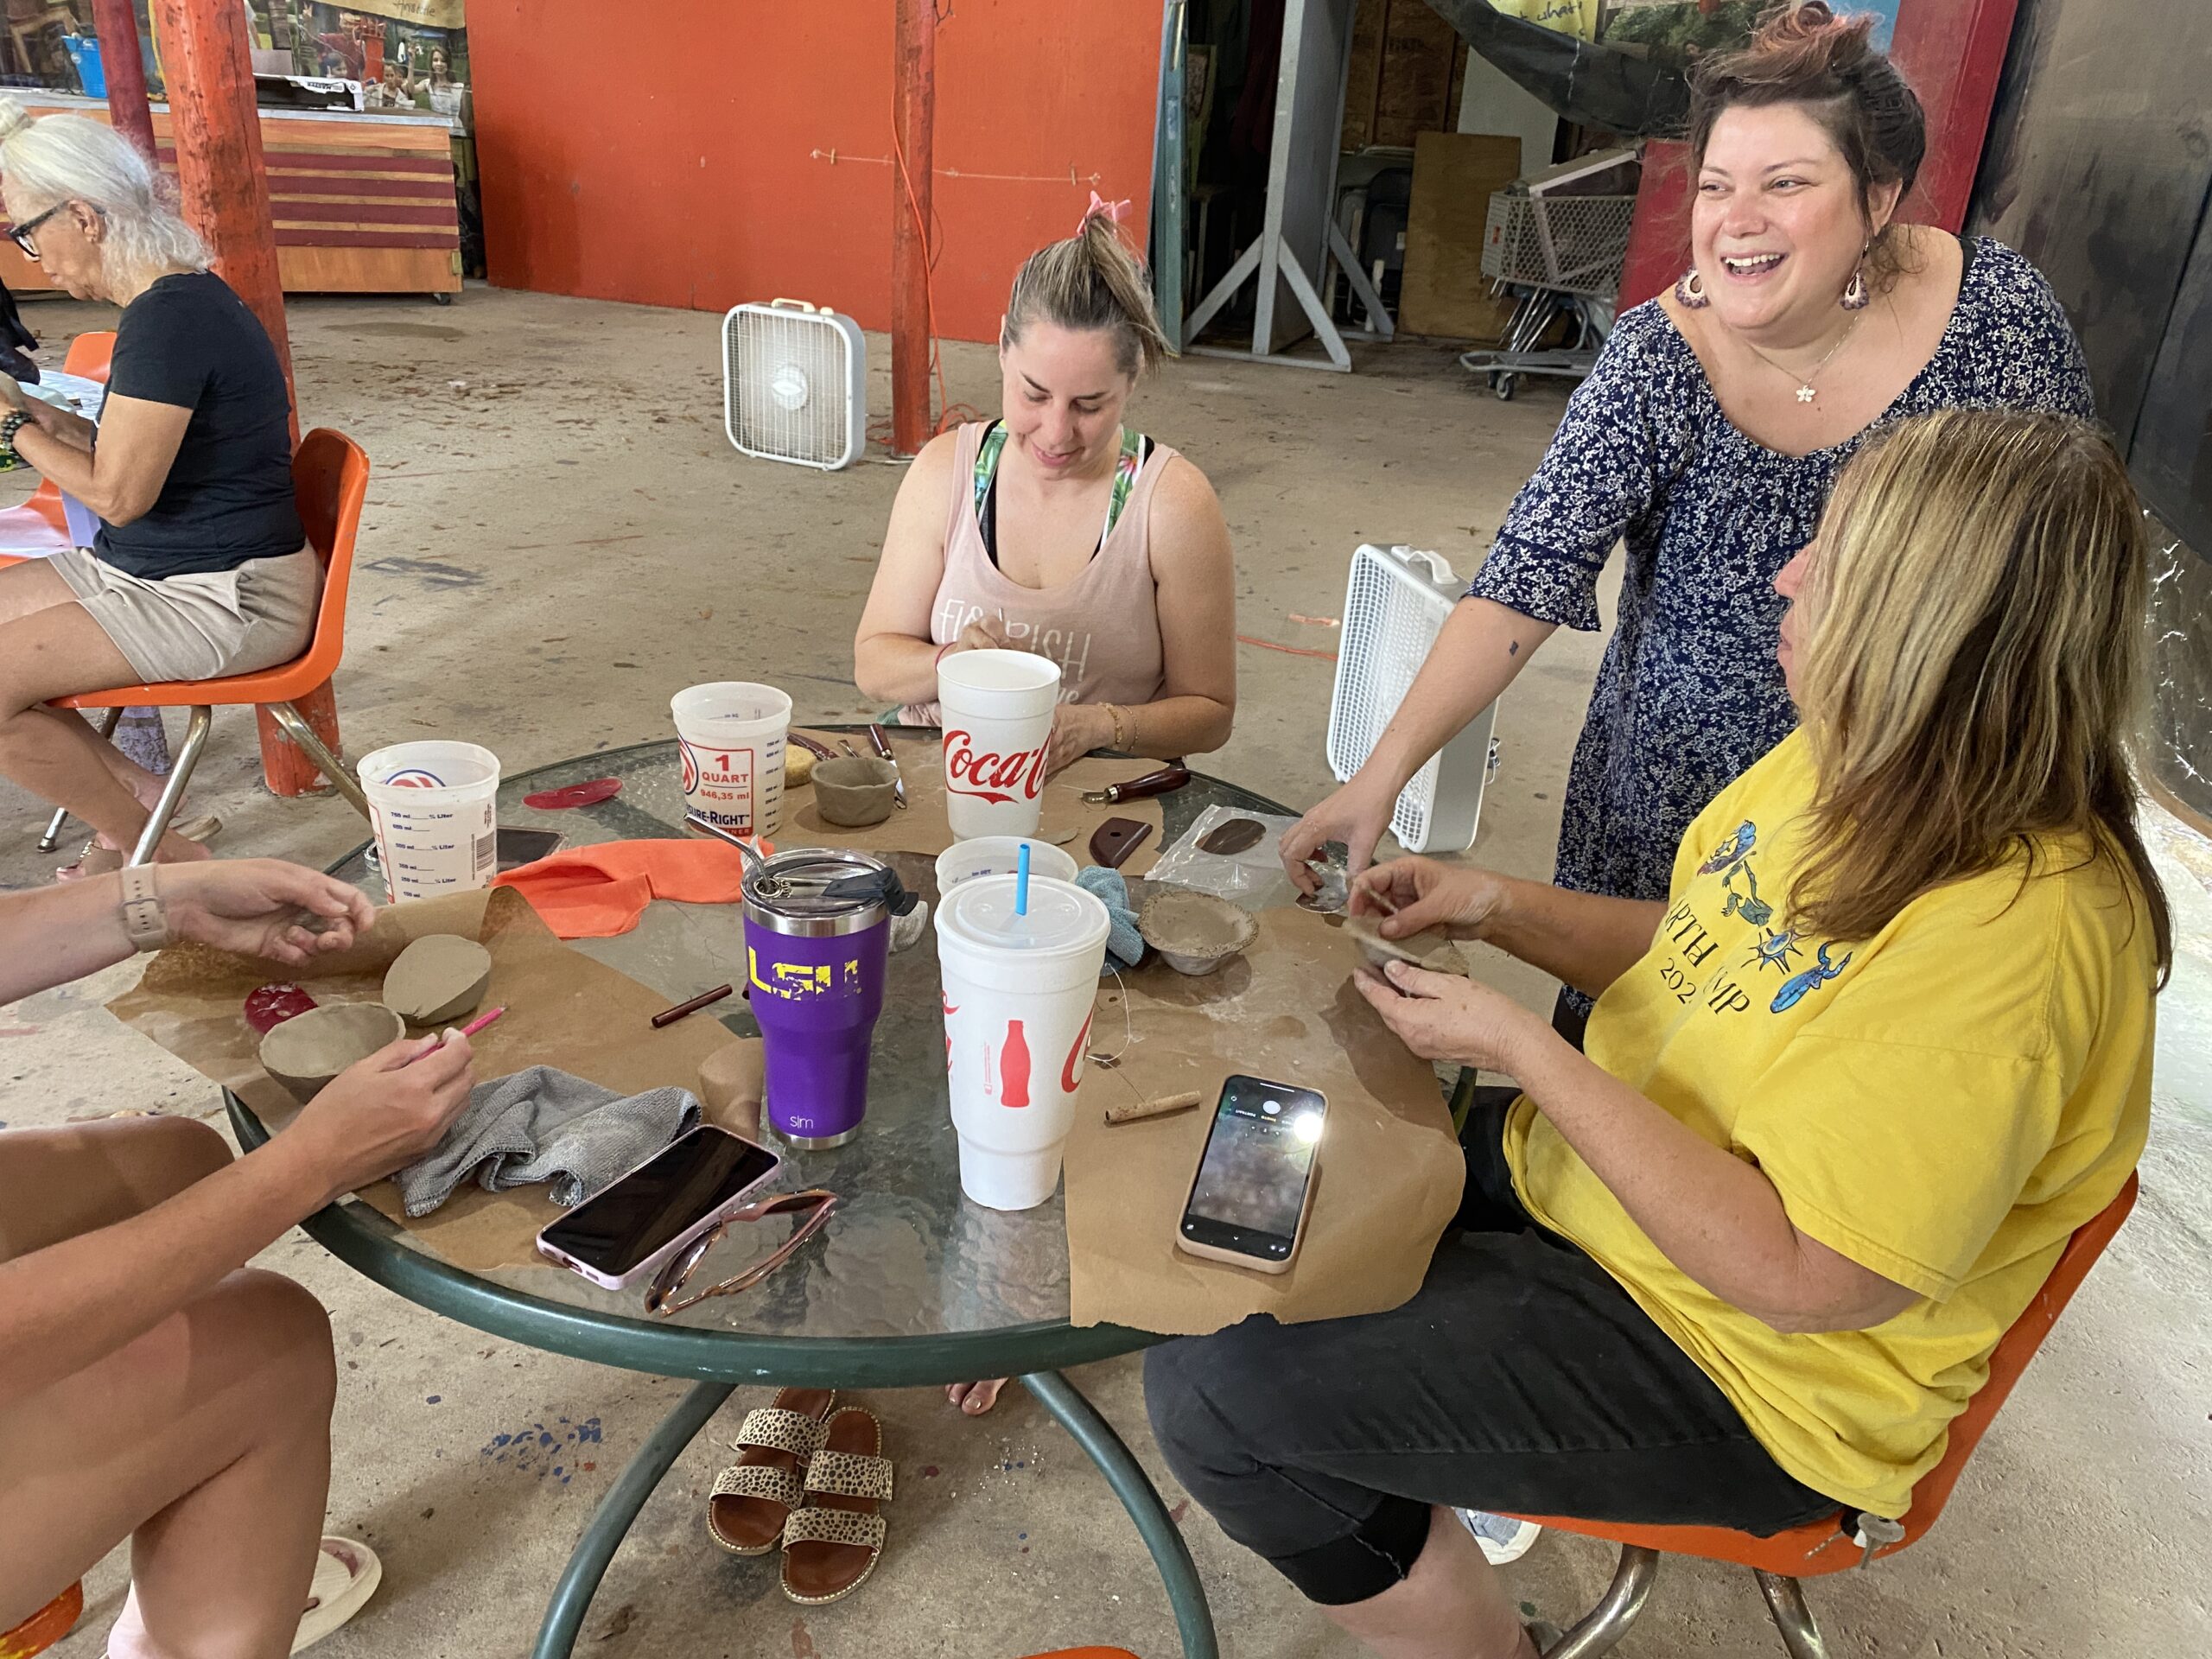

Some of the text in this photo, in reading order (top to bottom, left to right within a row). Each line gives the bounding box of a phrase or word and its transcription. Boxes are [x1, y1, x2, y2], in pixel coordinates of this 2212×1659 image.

[715, 754, 729, 771] 1
[702, 771, 748, 783] QUART
[700, 789, 749, 800] 946,35 ml
[1660, 957, 1696, 1004] 202
